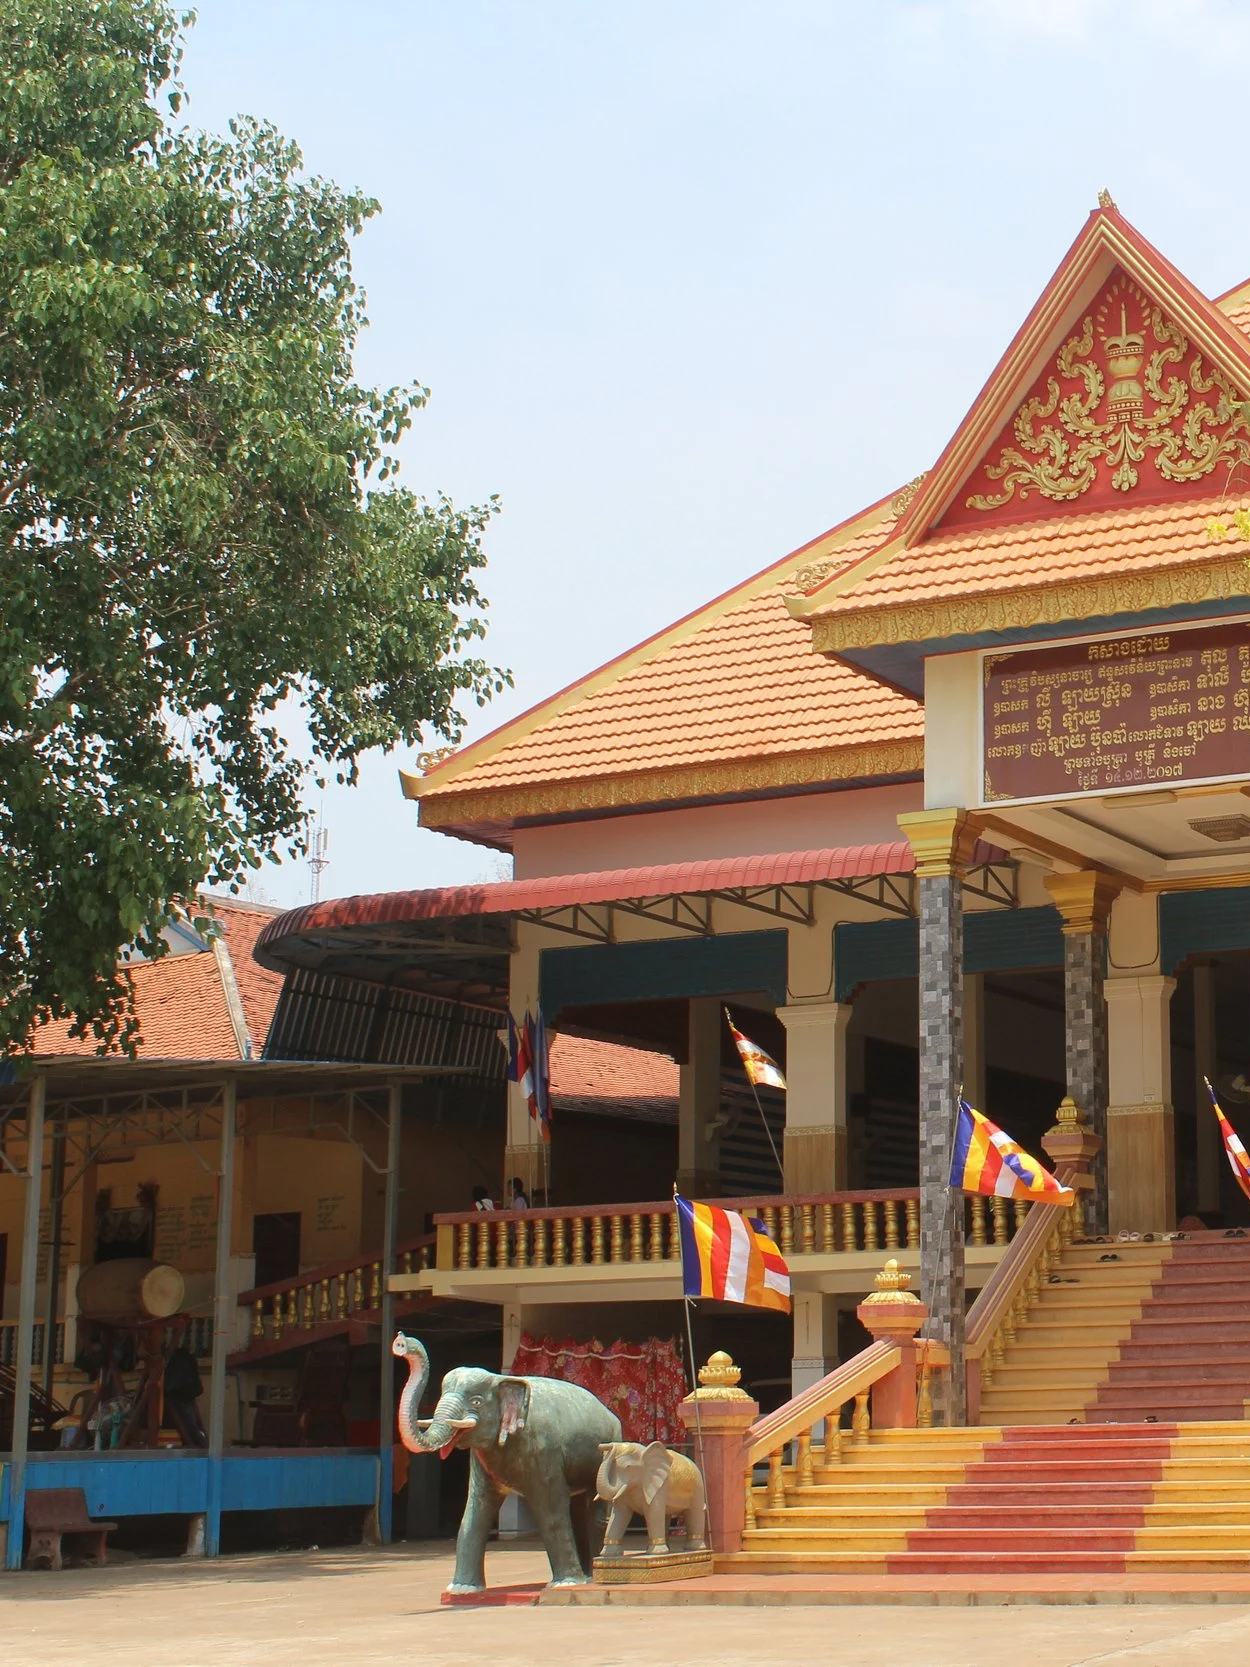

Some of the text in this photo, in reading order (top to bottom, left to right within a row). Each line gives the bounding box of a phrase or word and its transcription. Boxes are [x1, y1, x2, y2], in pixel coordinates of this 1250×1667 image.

[1088, 636, 1170, 661] កសាងដោយ
[993, 699, 1029, 717] ឧបាសក
[1036, 687, 1051, 708] លី
[1149, 676, 1191, 699] ឧបាសិកា
[994, 722, 1029, 739] ឧបាសក
[1062, 710, 1101, 733] ឡាយ
[1150, 698, 1191, 721] ឧបាសិកា
[1197, 695, 1226, 712] នាង
[1048, 734, 1087, 757] ឡាយ
[1187, 718, 1226, 742] ឡាយ
[1163, 742, 1197, 759] និងចៅ
